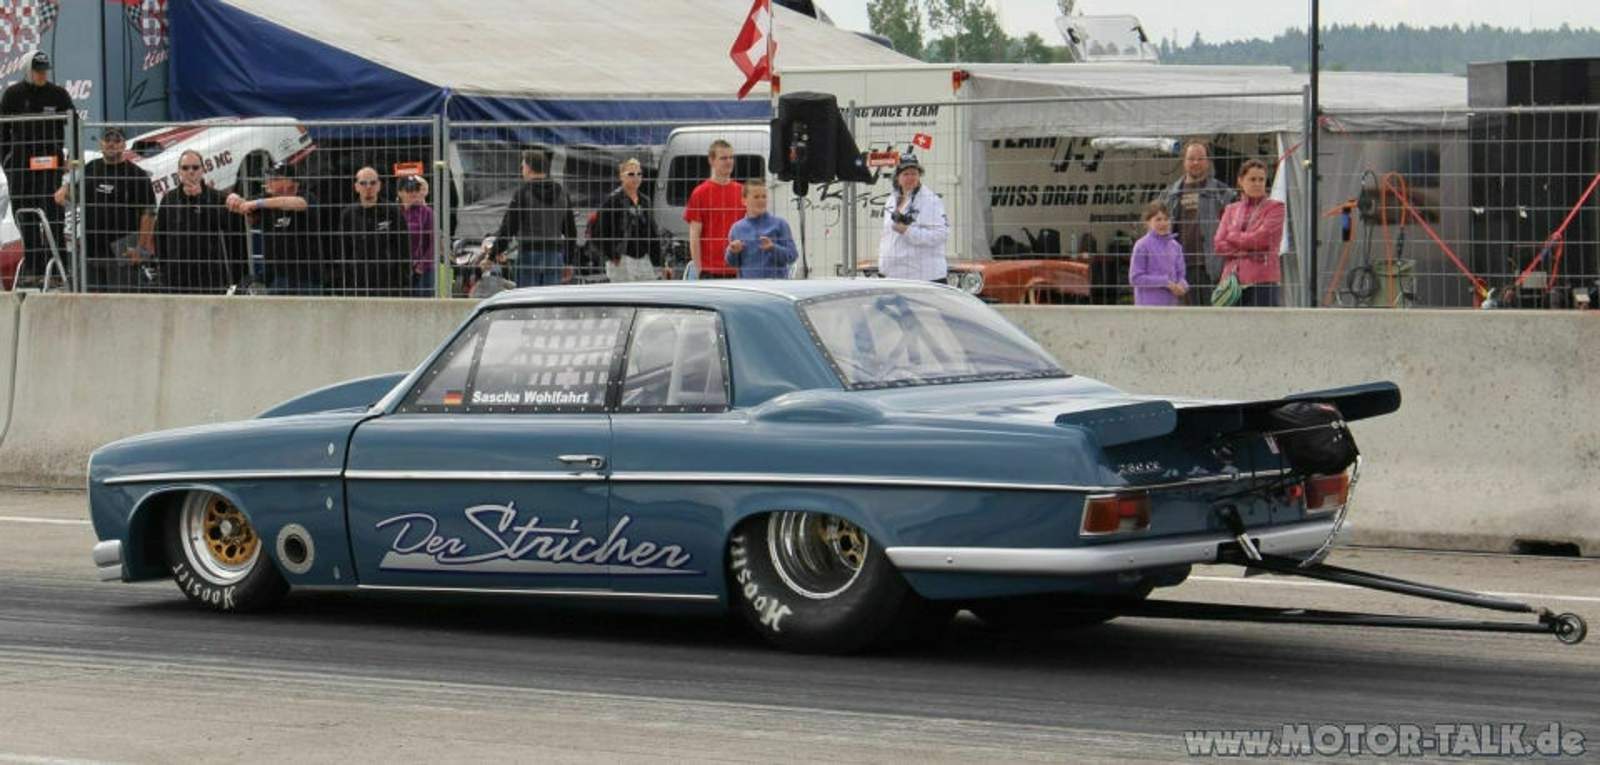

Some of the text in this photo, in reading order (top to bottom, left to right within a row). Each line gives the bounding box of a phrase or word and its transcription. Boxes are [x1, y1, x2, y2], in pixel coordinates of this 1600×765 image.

[906, 104, 940, 117] TEAM
[989, 184, 1039, 207] WISS
[1041, 183, 1090, 207] DRAG
[1092, 182, 1136, 205] RACE
[472, 390, 589, 404] Sascha Wohlfahrt
[376, 501, 690, 568] Der Stricher
